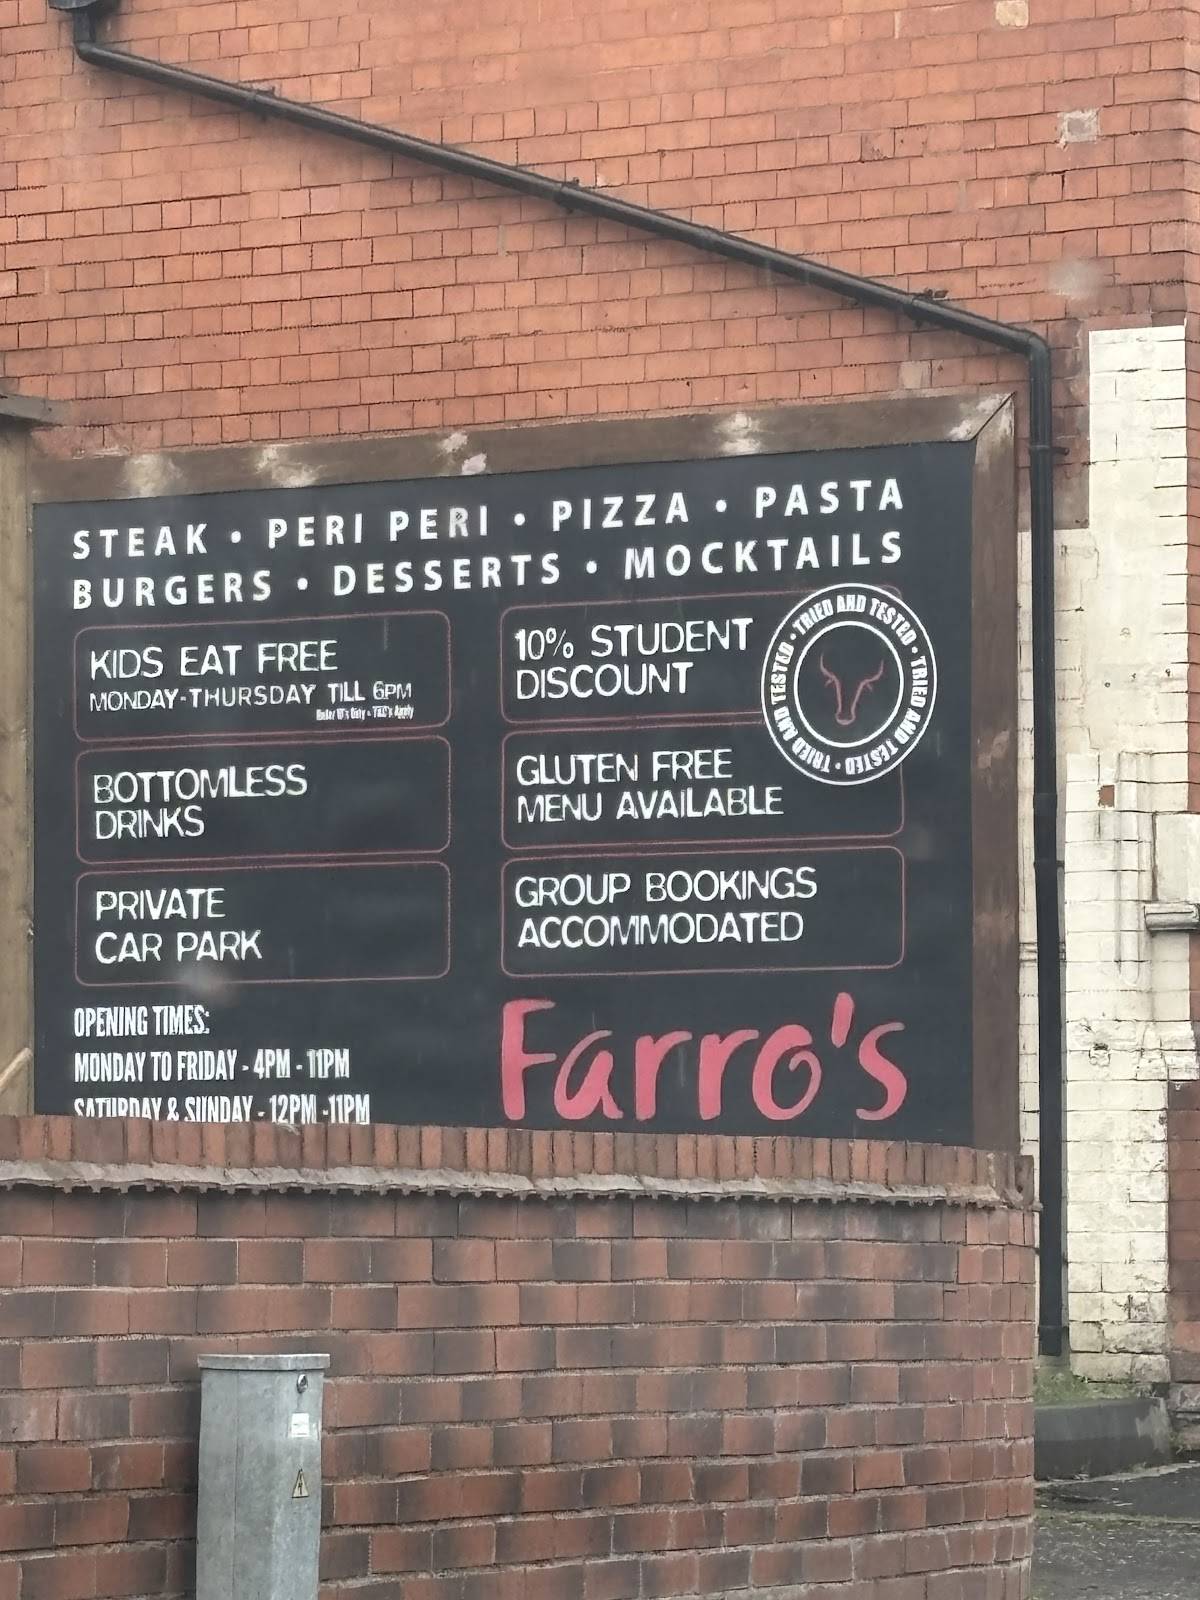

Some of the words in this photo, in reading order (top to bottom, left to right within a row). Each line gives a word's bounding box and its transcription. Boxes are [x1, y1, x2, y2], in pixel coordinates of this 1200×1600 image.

[73, 523, 207, 559] STEAK
[267, 513, 362, 549] PERI
[390, 505, 487, 541] PERI
[552, 492, 688, 531] PIZZA
[756, 479, 903, 518] PASTA
[72, 570, 271, 609] BURGERS
[333, 553, 560, 596] DESSERTS
[625, 531, 901, 580] MOCKTAILS
[792, 599, 834, 635] TRIED
[837, 594, 866, 614] AND
[870, 598, 917, 646] TESTED
[514, 627, 573, 661] 10%
[591, 618, 753, 657] STUDENT
[91, 646, 163, 680] KIDS
[180, 645, 242, 676] EAT
[258, 640, 338, 673] FREE
[771, 641, 794, 704] TESTED
[90, 684, 317, 712] MONDAY-THURSDAY
[327, 680, 365, 704] TILL
[373, 681, 411, 701] 6PM
[517, 661, 693, 699] DISCOUNT
[910, 656, 928, 708] TRIED
[773, 707, 798, 741] AND
[895, 708, 920, 744] AND
[517, 753, 638, 786] GLUTEN
[653, 749, 732, 781] FREE
[792, 740, 830, 773] TRIED
[846, 739, 899, 775] TESTED
[94, 764, 307, 804] BOTTOMLESS
[95, 806, 204, 839] DRINKS
[518, 792, 602, 823] MENU
[616, 785, 784, 819] AVAILABLE
[96, 888, 225, 920] PRIVATE
[515, 873, 631, 907] GROUP
[646, 866, 817, 902] BOOKINGS
[95, 932, 162, 964] CAR
[177, 930, 262, 962] PARK
[518, 912, 803, 948] ACCOMMODATED
[74, 1006, 148, 1037] OPENING
[152, 1005, 209, 1035] TIMES:
[75, 1052, 146, 1082] MONDAY
[150, 1051, 172, 1081] TO
[177, 1049, 237, 1081] FRIDAY
[253, 1049, 290, 1079] 4PM
[307, 1048, 349, 1078] 11PM
[502, 991, 908, 1119] Farro's
[168, 1097, 179, 1121] &
[184, 1095, 253, 1122] SUNDAY
[269, 1094, 317, 1124] 12PM
